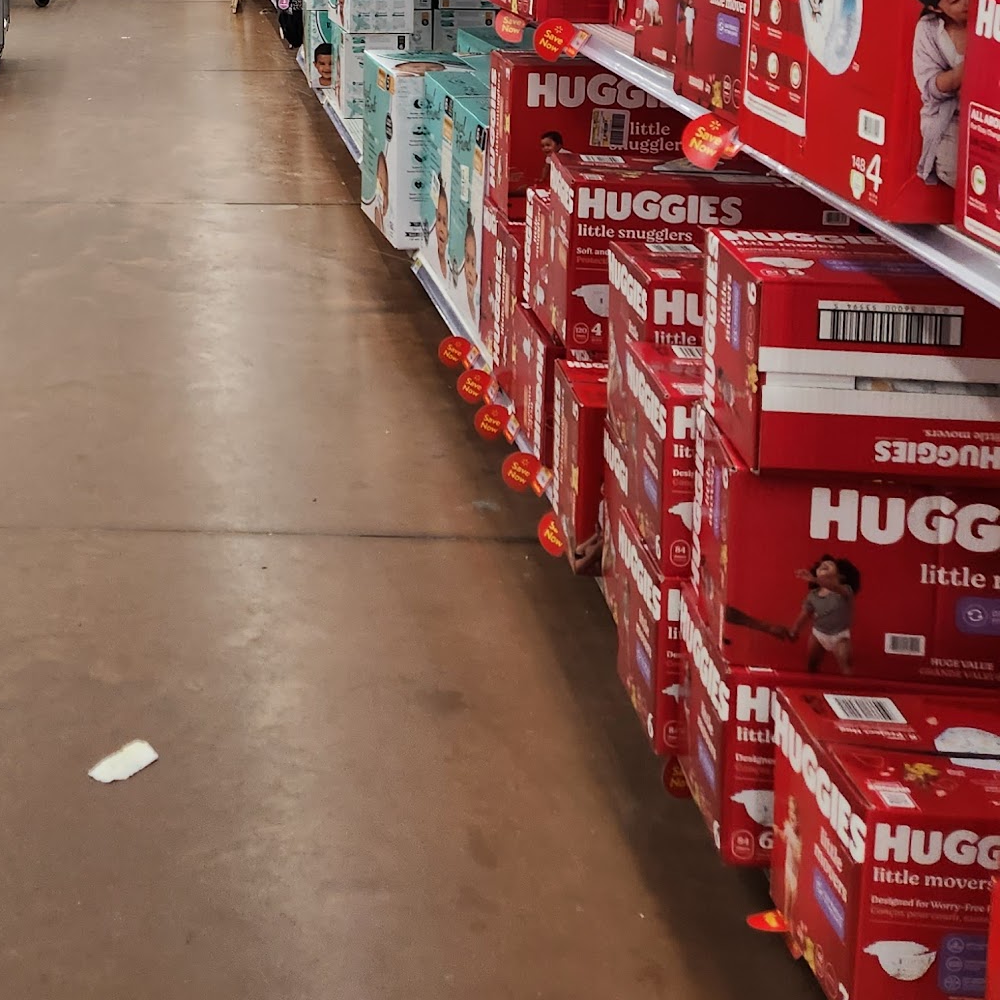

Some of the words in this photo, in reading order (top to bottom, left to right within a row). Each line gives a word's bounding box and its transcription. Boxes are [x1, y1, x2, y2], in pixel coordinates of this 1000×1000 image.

[501, 24, 521, 34] Now
[502, 15, 521, 26] Save
[543, 29, 564, 45] Save
[539, 38, 559, 54] Now
[630, 121, 670, 136] little
[695, 127, 720, 147] Save
[690, 139, 718, 157] Now
[852, 155, 866, 171] 148
[866, 154, 883, 193] 4
[577, 187, 742, 226] HUGGIES
[577, 223, 615, 238] little
[618, 227, 692, 242] snugglers
[577, 247, 592, 255] Soft
[608, 249, 648, 321] HUGGIES
[748, 282, 756, 306] 6
[591, 323, 602, 336] 4
[654, 330, 696, 345] little
[442, 350, 460, 362] Now
[446, 342, 462, 356] Save
[461, 384, 479, 398] Now
[466, 376, 482, 390] Save
[626, 352, 667, 440] HUGGIES
[479, 422, 498, 434] Now
[482, 414, 502, 428] Save
[511, 460, 530, 477] Save
[507, 470, 528, 485] Now
[544, 528, 564, 548] Now
[674, 546, 686, 554] 84
[618, 520, 662, 621] HUGGIES
[920, 563, 986, 588] little
[680, 599, 730, 721] HUGGIES
[647, 712, 654, 739] 6
[774, 700, 868, 864] HUGGIES
[759, 832, 774, 850] 6
[873, 867, 920, 886] little
[871, 896, 914, 908] Designed
[915, 898, 929, 908] for
[930, 900, 981, 913] Worry-Free
